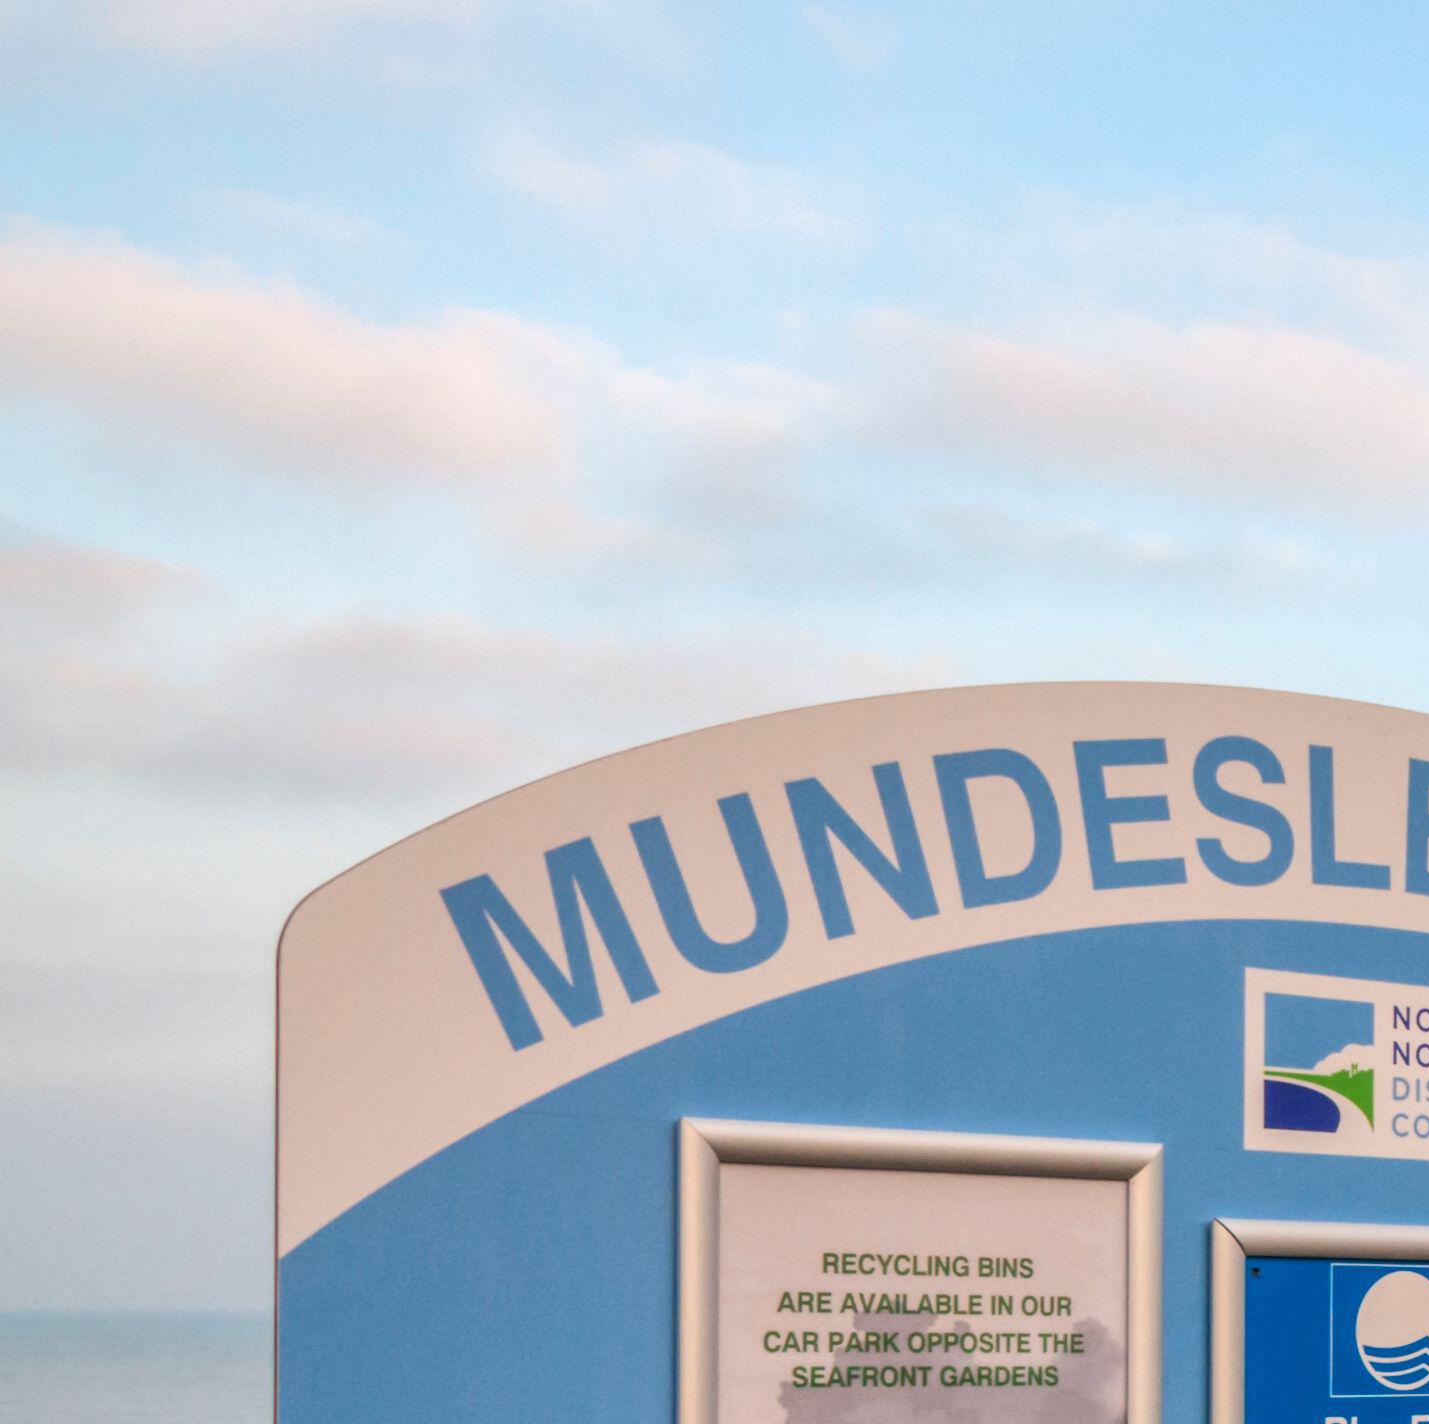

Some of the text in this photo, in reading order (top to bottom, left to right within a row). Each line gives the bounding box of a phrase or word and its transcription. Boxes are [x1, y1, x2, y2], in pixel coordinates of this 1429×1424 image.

[822, 1253, 1034, 1278] RECYCLING BINS
[777, 1292, 1072, 1317] ARE AVAILABLE IN OUR
[763, 1331, 1084, 1355] CAR PARK OPPOSITE THE
[792, 1366, 1059, 1389] SEAFRONT GARDENS
